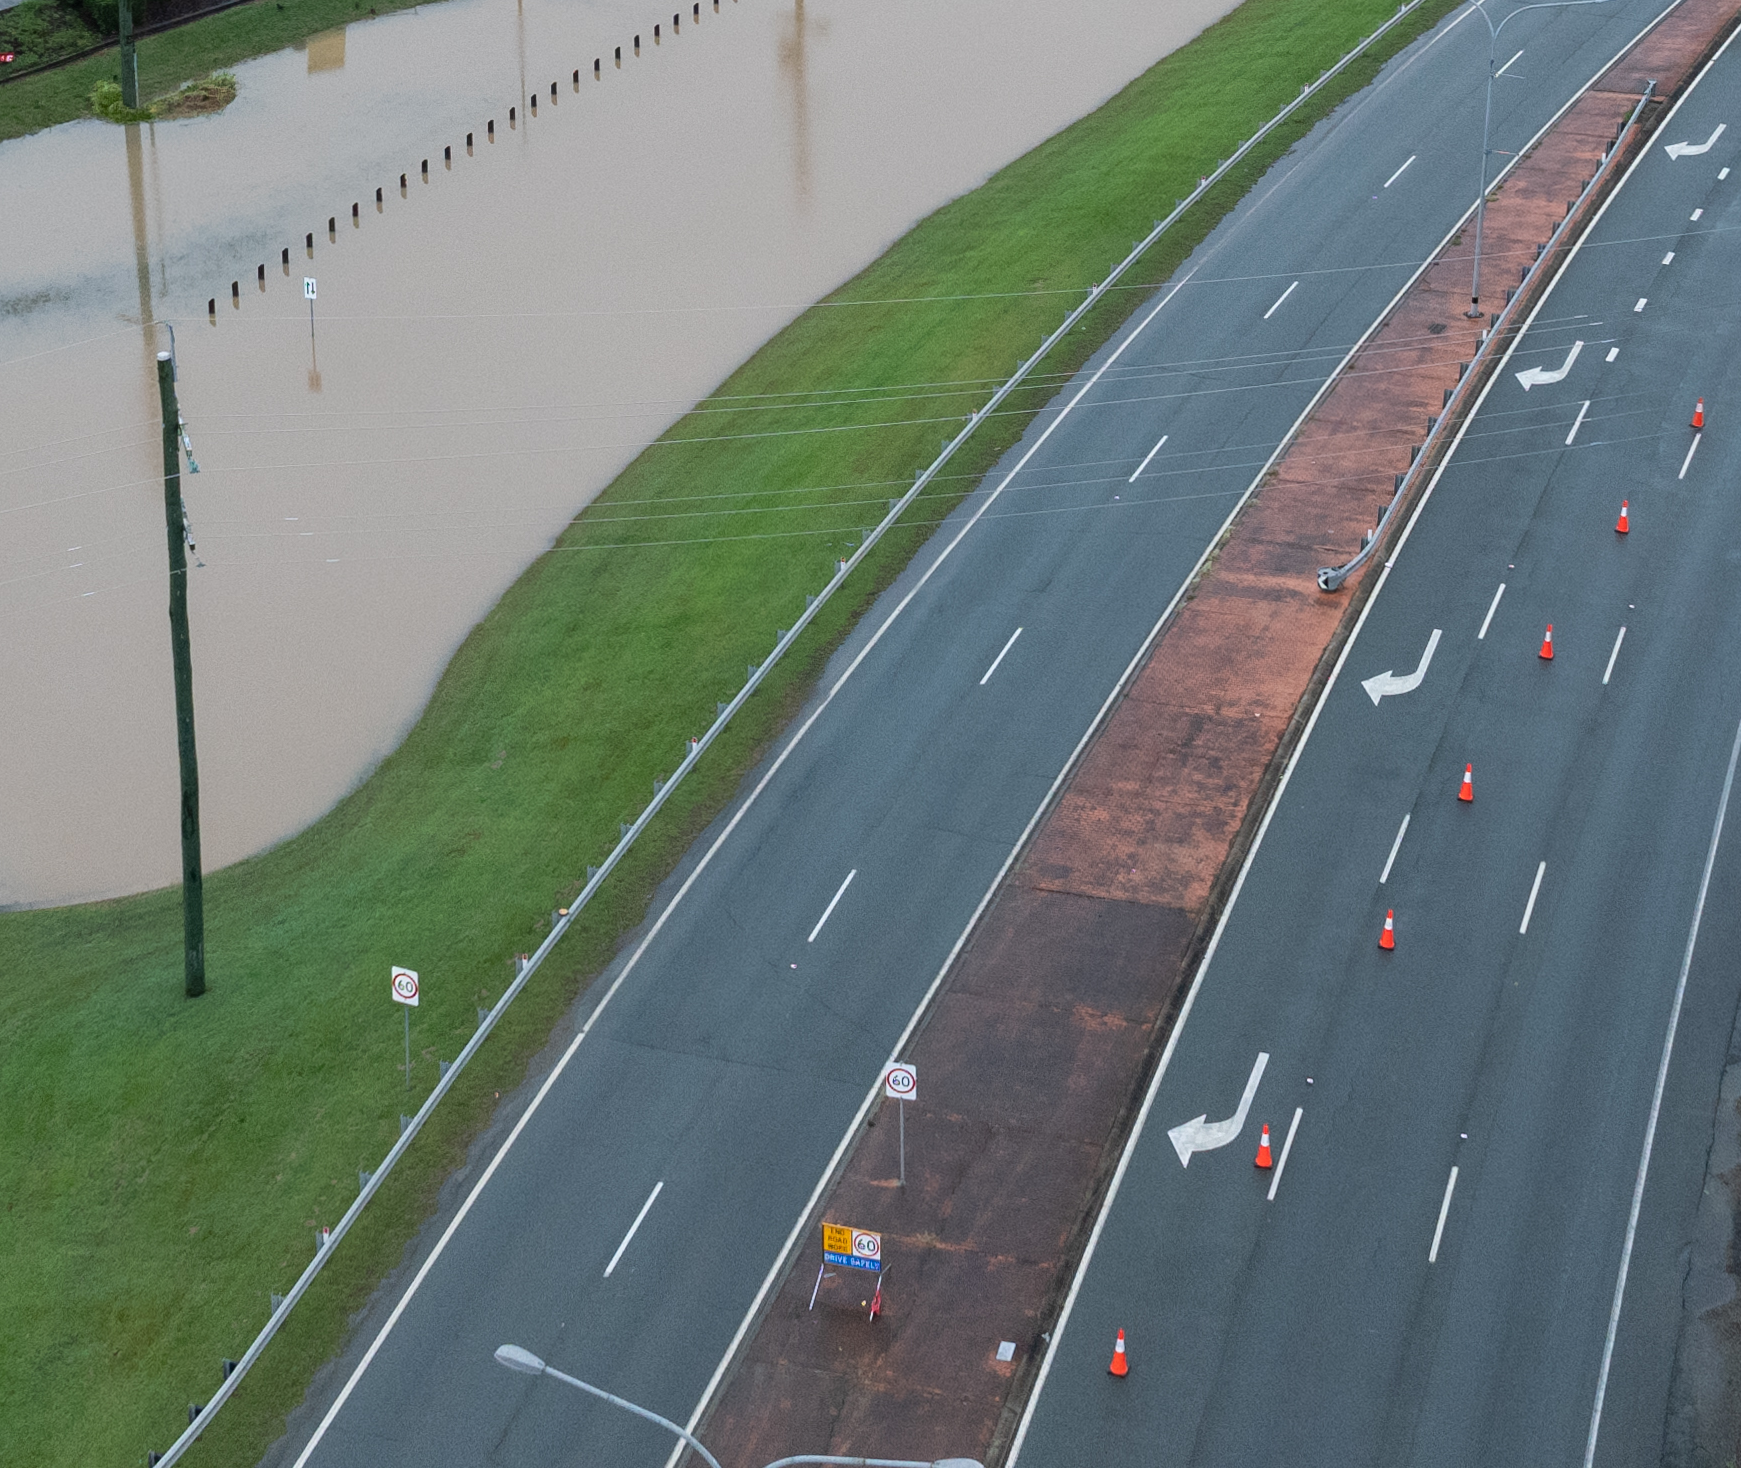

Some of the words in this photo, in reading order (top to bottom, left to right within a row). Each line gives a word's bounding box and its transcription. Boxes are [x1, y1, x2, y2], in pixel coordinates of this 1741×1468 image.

[397, 980, 414, 993] 60
[892, 1075, 910, 1088] 60
[830, 1228, 845, 1236] END
[827, 1236, 848, 1244] ROAD
[858, 1238, 876, 1252] 60
[824, 1253, 848, 1264] DRIVE
[850, 1257, 880, 1270] SAFELY
